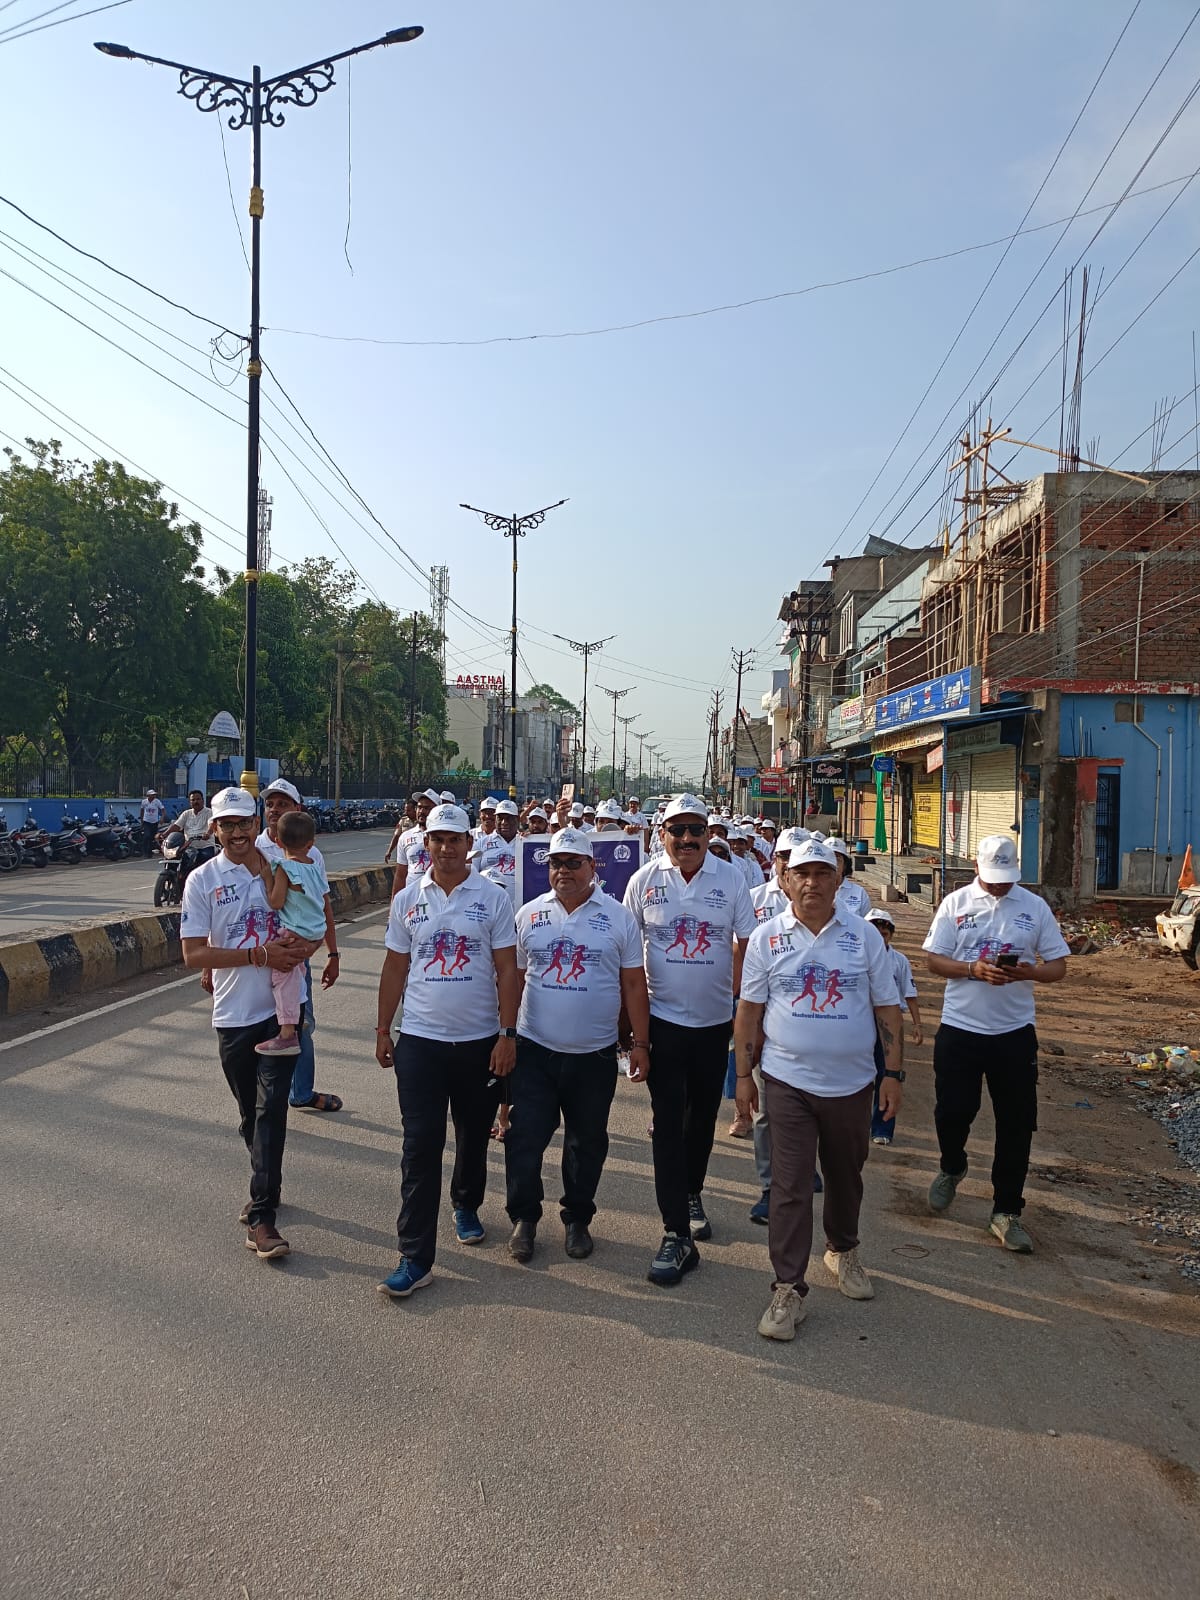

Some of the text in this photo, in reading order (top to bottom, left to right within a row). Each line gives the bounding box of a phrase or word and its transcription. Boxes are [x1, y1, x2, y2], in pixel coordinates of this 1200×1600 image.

[456, 674, 502, 684] AASTHA
[216, 895, 240, 906] INDIA
[647, 898, 669, 906] INDIA
[408, 915, 429, 926] INDIA
[531, 920, 552, 930] INDIA
[958, 923, 978, 931] INDIA
[771, 945, 795, 956] INDIA
